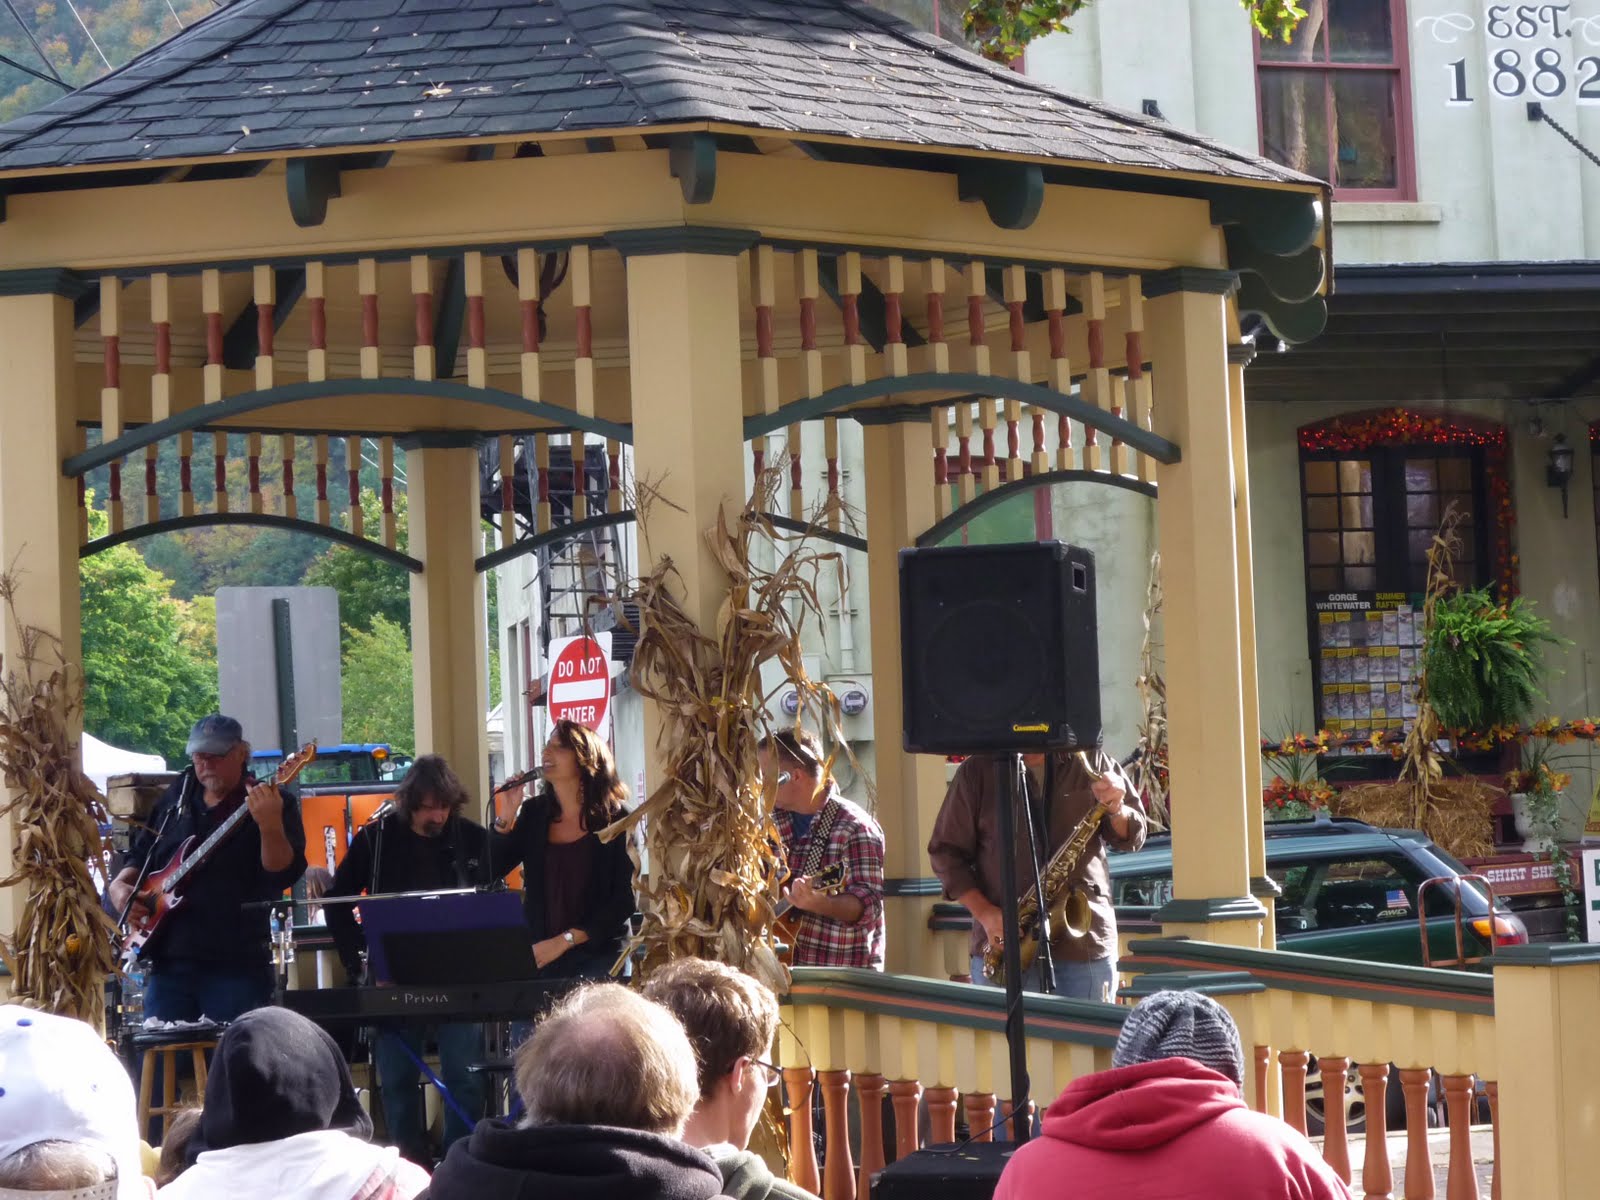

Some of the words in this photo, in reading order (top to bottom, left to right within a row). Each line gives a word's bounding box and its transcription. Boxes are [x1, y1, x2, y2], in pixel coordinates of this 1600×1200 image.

[1487, 5, 1572, 38] EST.
[1447, 48, 1600, 102] 1882
[1328, 593, 1358, 601] GORGE
[1375, 592, 1405, 600] SUMMER
[1316, 601, 1371, 610] WHITEWATER
[558, 660, 574, 678] DO
[580, 656, 602, 676] NOT
[560, 705, 596, 723] ENTER
[1376, 908, 1408, 918] AWD
